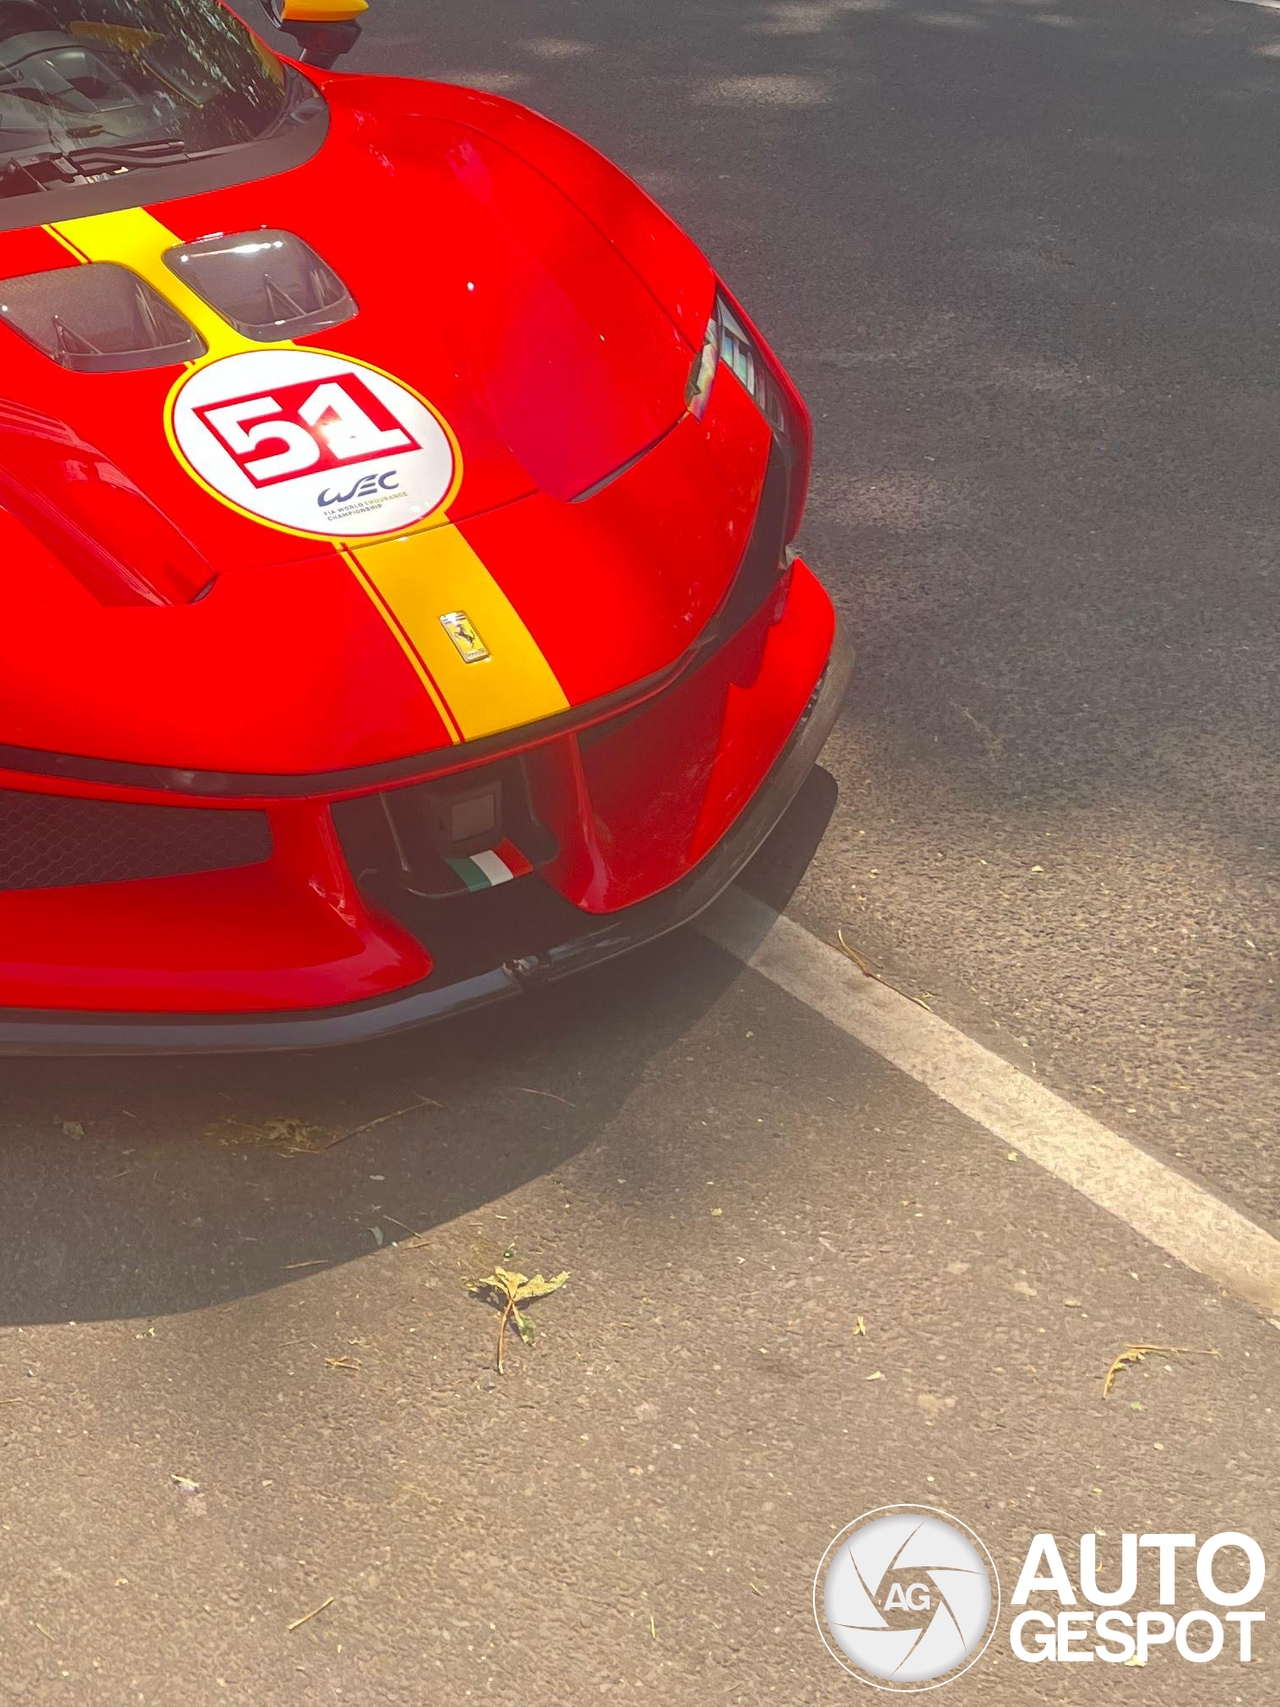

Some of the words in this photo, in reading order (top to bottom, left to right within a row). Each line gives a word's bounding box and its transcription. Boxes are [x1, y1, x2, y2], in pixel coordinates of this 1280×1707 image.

[203, 381, 413, 482] 51
[317, 469, 400, 507] WEC
[323, 509, 336, 517] FIA
[337, 502, 364, 513] WORLD
[364, 491, 409, 506] ENDURANCE
[327, 503, 383, 522] CHAMPIONSHIP
